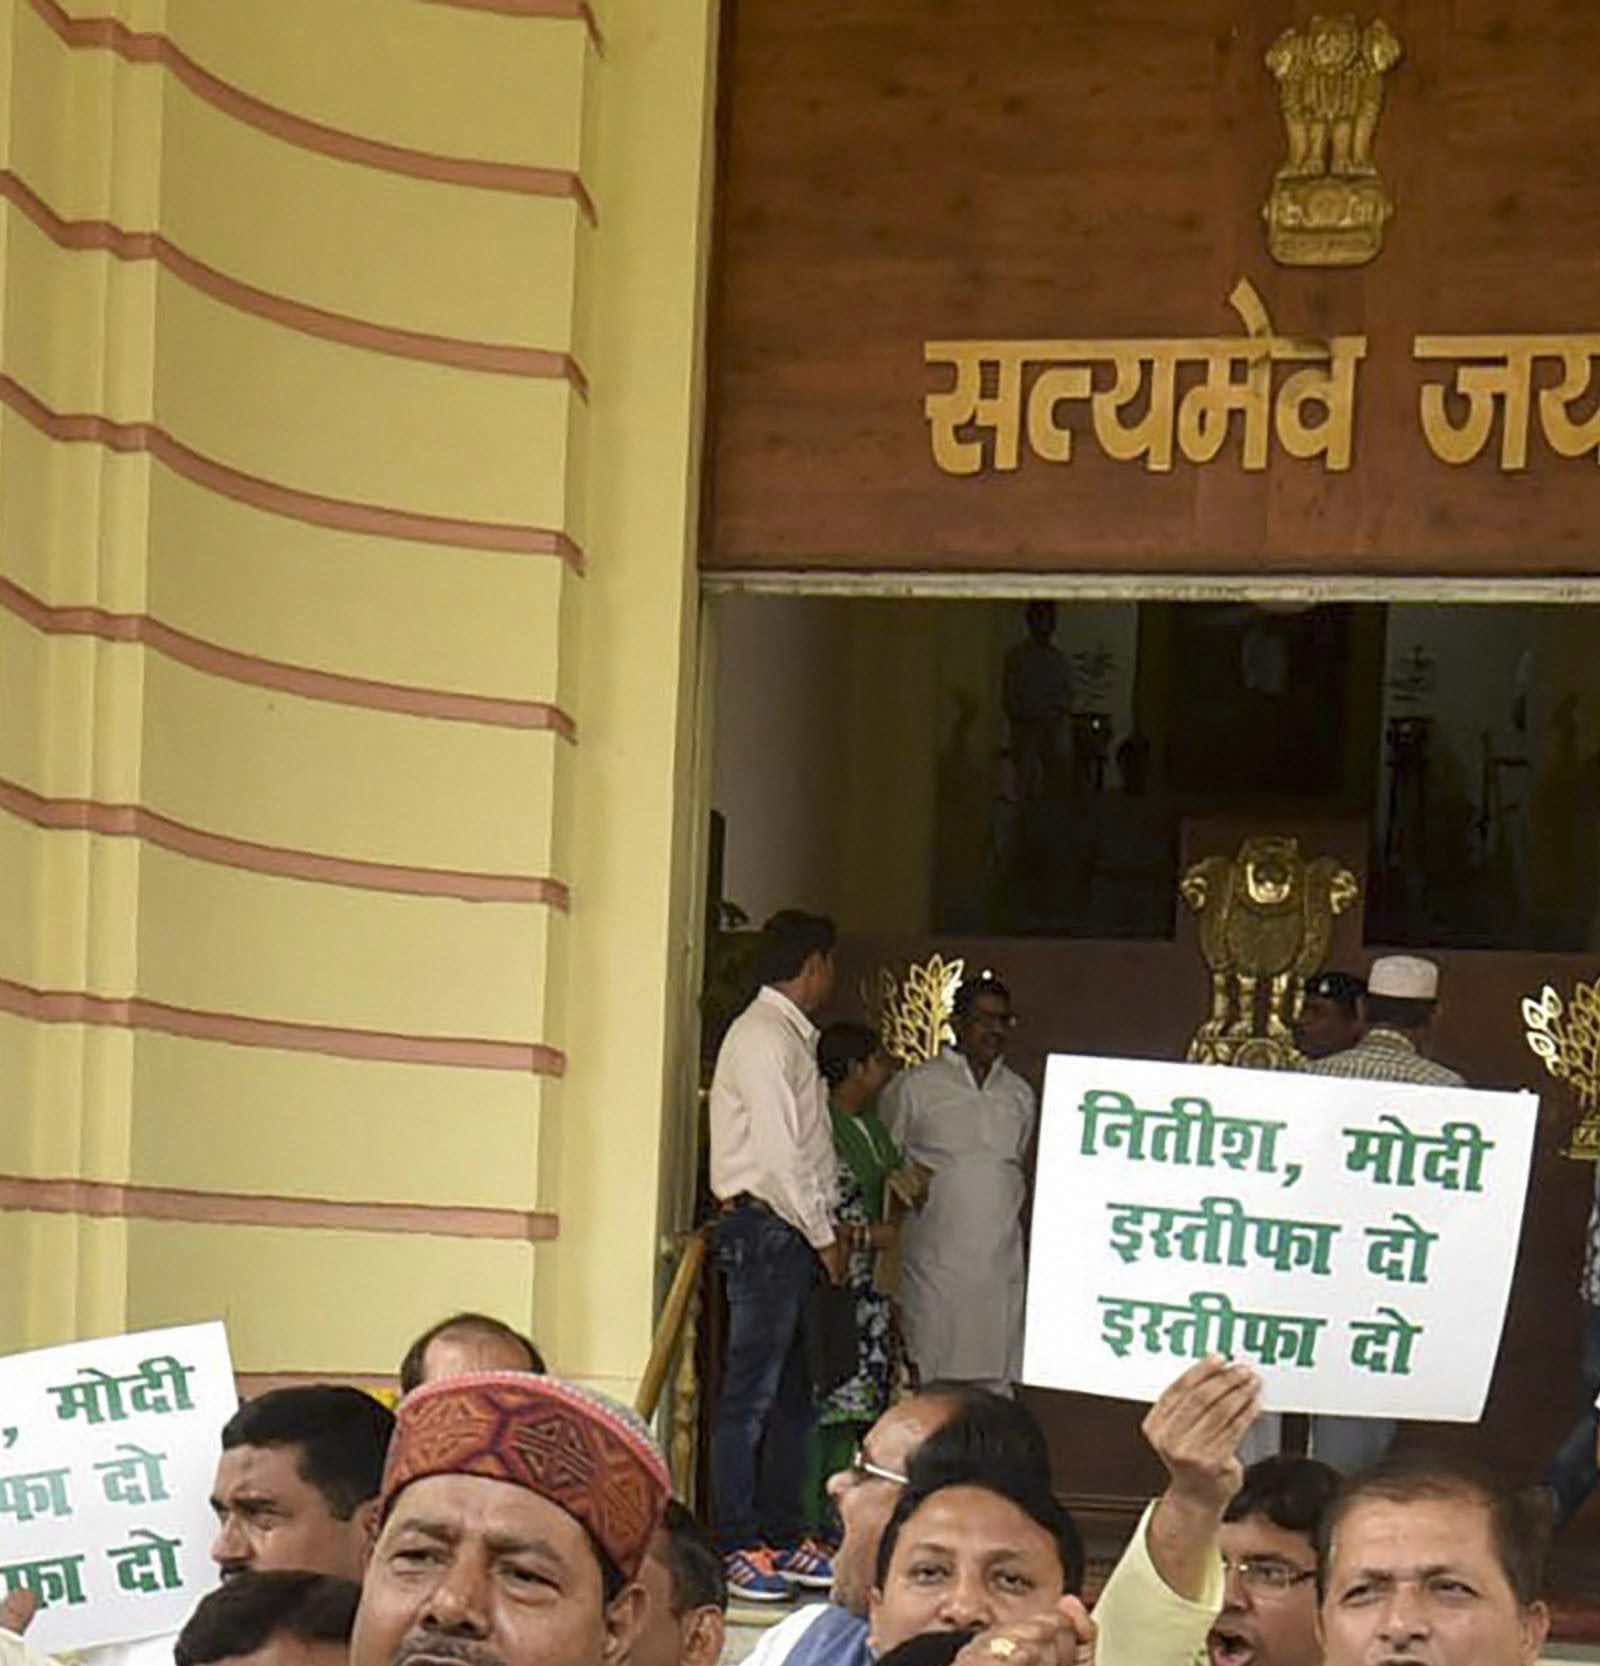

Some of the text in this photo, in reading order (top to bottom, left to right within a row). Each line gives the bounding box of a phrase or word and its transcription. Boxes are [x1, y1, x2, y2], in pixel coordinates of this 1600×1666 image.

[923, 274, 1367, 475] सत्यमेव
[1079, 1089, 1495, 1192] नितीश, मोदी
[1107, 1196, 1438, 1283] इस्तीफा दो
[1098, 1291, 1424, 1375] इस्तीफा दो
[47, 1356, 195, 1424] मोदी
[94, 1444, 169, 1504] दो
[107, 1529, 183, 1592] दो
